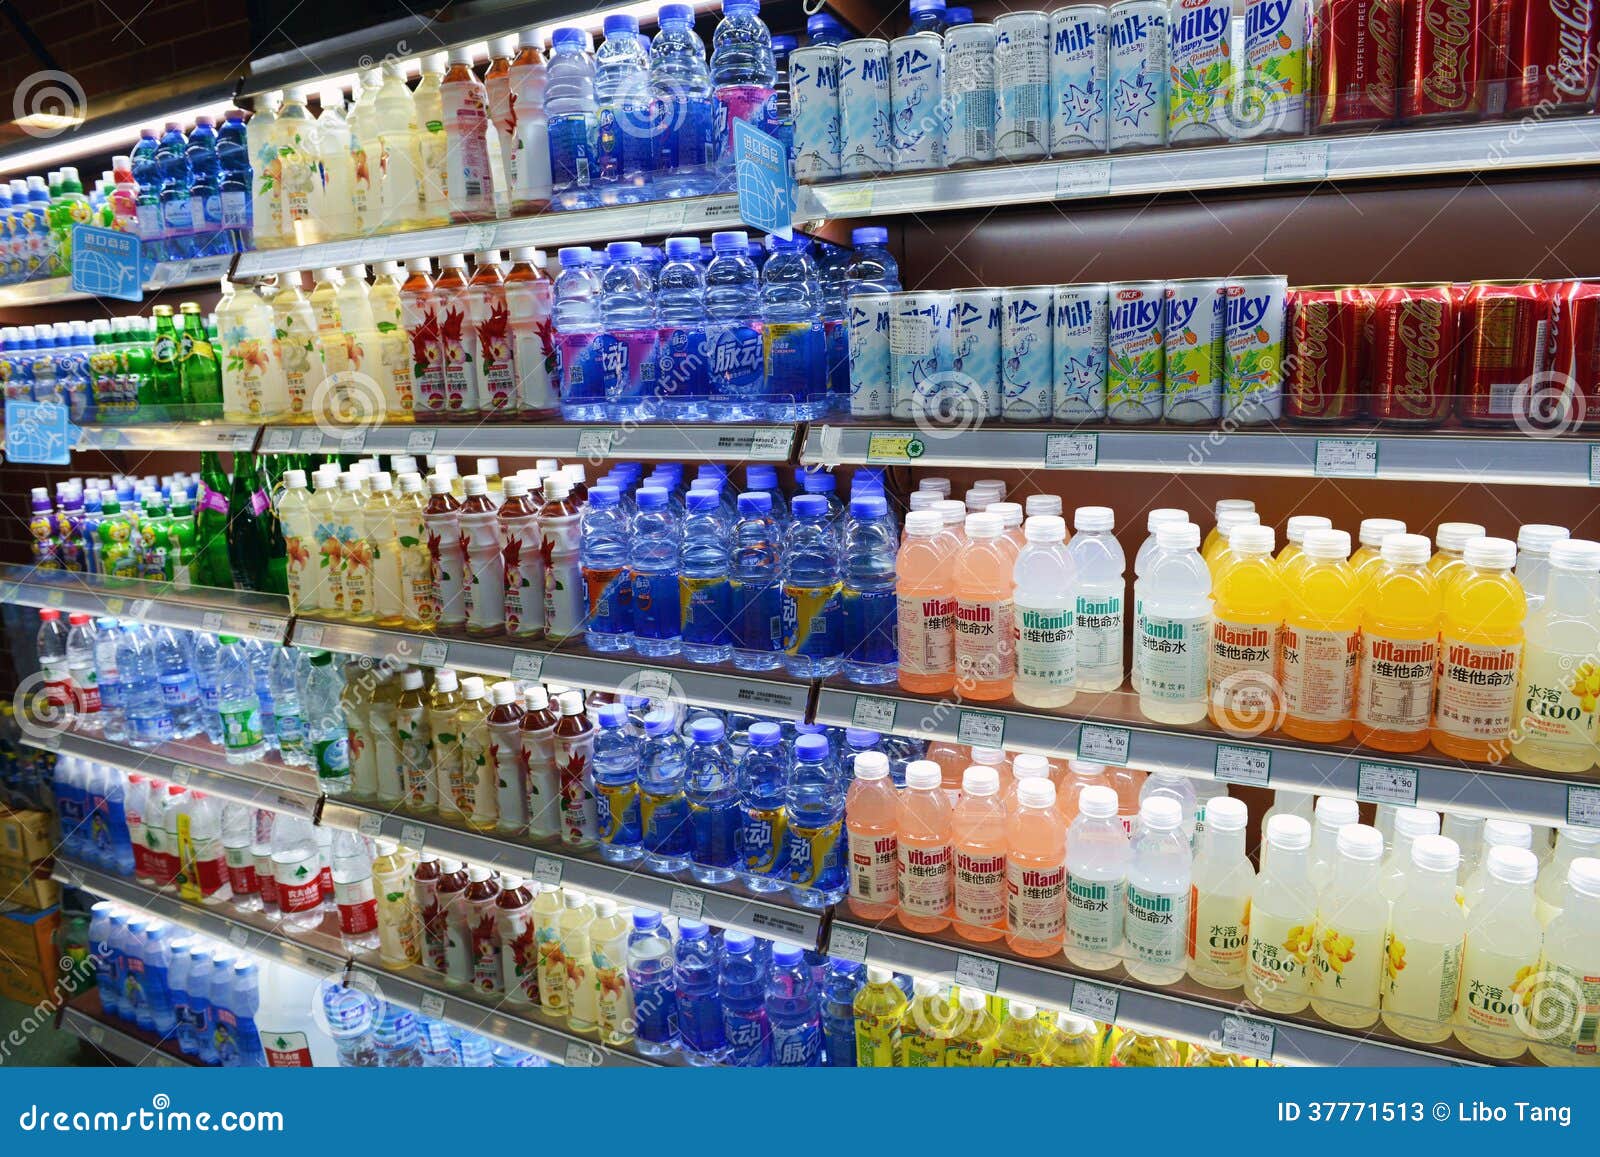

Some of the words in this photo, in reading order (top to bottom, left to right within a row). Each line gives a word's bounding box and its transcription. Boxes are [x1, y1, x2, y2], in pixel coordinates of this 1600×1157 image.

[1171, 6, 1230, 50] Milky
[1244, 0, 1293, 38] ilky
[1356, 31, 1365, 79] CAFFEINE
[1109, 298, 1163, 333] Milky
[1226, 295, 1271, 330] ilky
[1393, 296, 1443, 416] Coca-Cola
[1075, 596, 1120, 615] itamin
[1023, 609, 1074, 630] vitamin
[1214, 622, 1268, 647] vitamin
[1373, 640, 1434, 663] vitamin
[1450, 645, 1514, 671] vitamin
[1453, 666, 1515, 687] 维他命水
[1471, 979, 1504, 1000] 水溶
